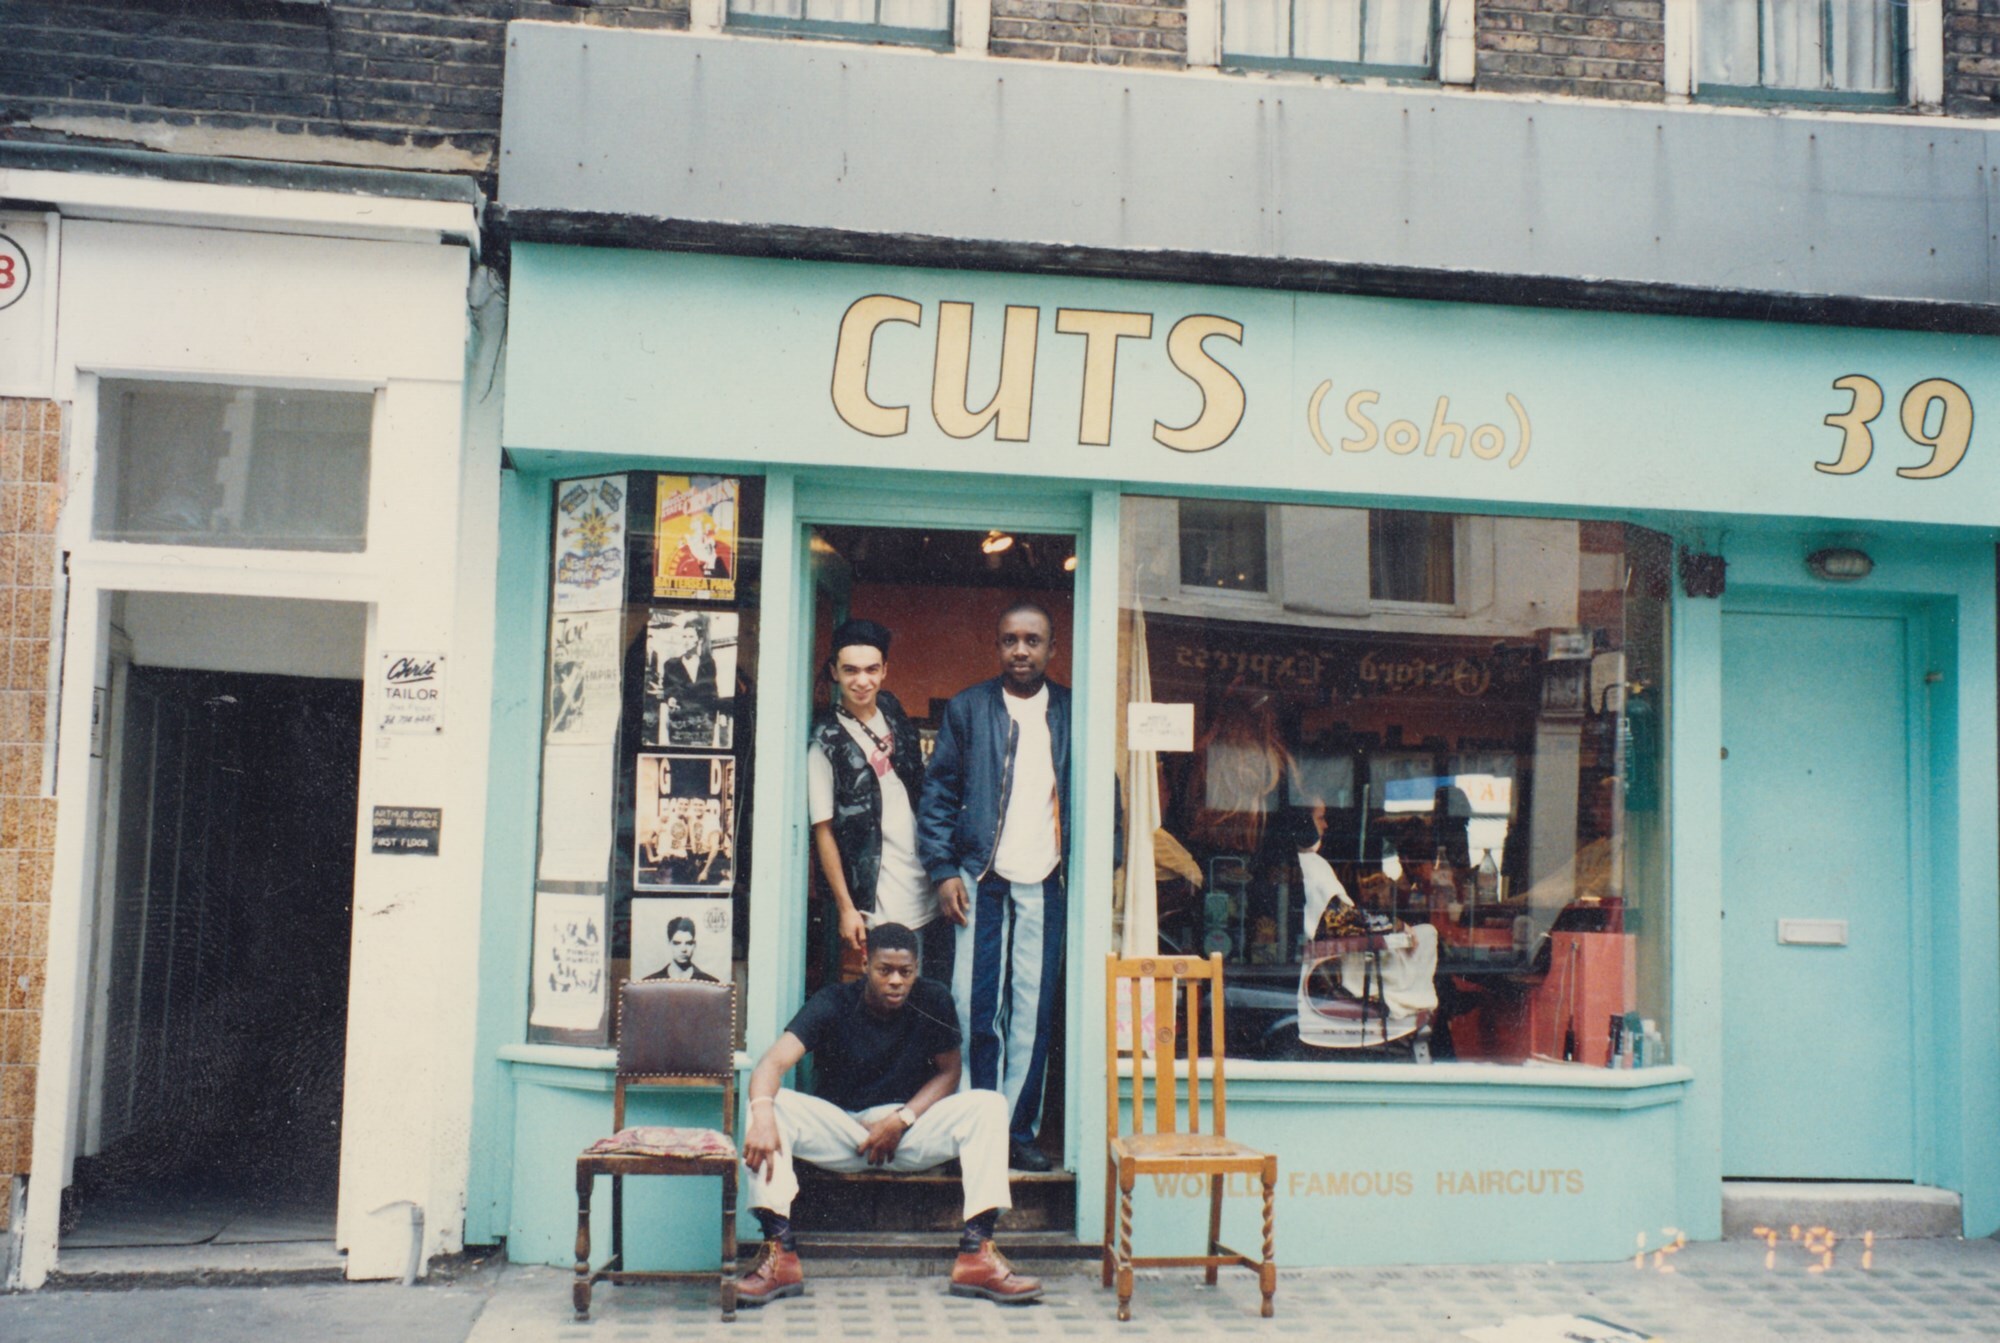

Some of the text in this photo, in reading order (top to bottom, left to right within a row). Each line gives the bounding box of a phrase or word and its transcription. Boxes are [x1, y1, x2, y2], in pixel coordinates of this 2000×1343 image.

[830, 293, 1531, 469] CUTS (Soho)
[1815, 374, 1975, 479] 39
[387, 657, 437, 680] Chris
[385, 687, 438, 700] TAILOR
[373, 837, 428, 848] FIRST FLOOR
[1154, 1169, 1584, 1199] WOLD FAMOUS HAIRCUTS
